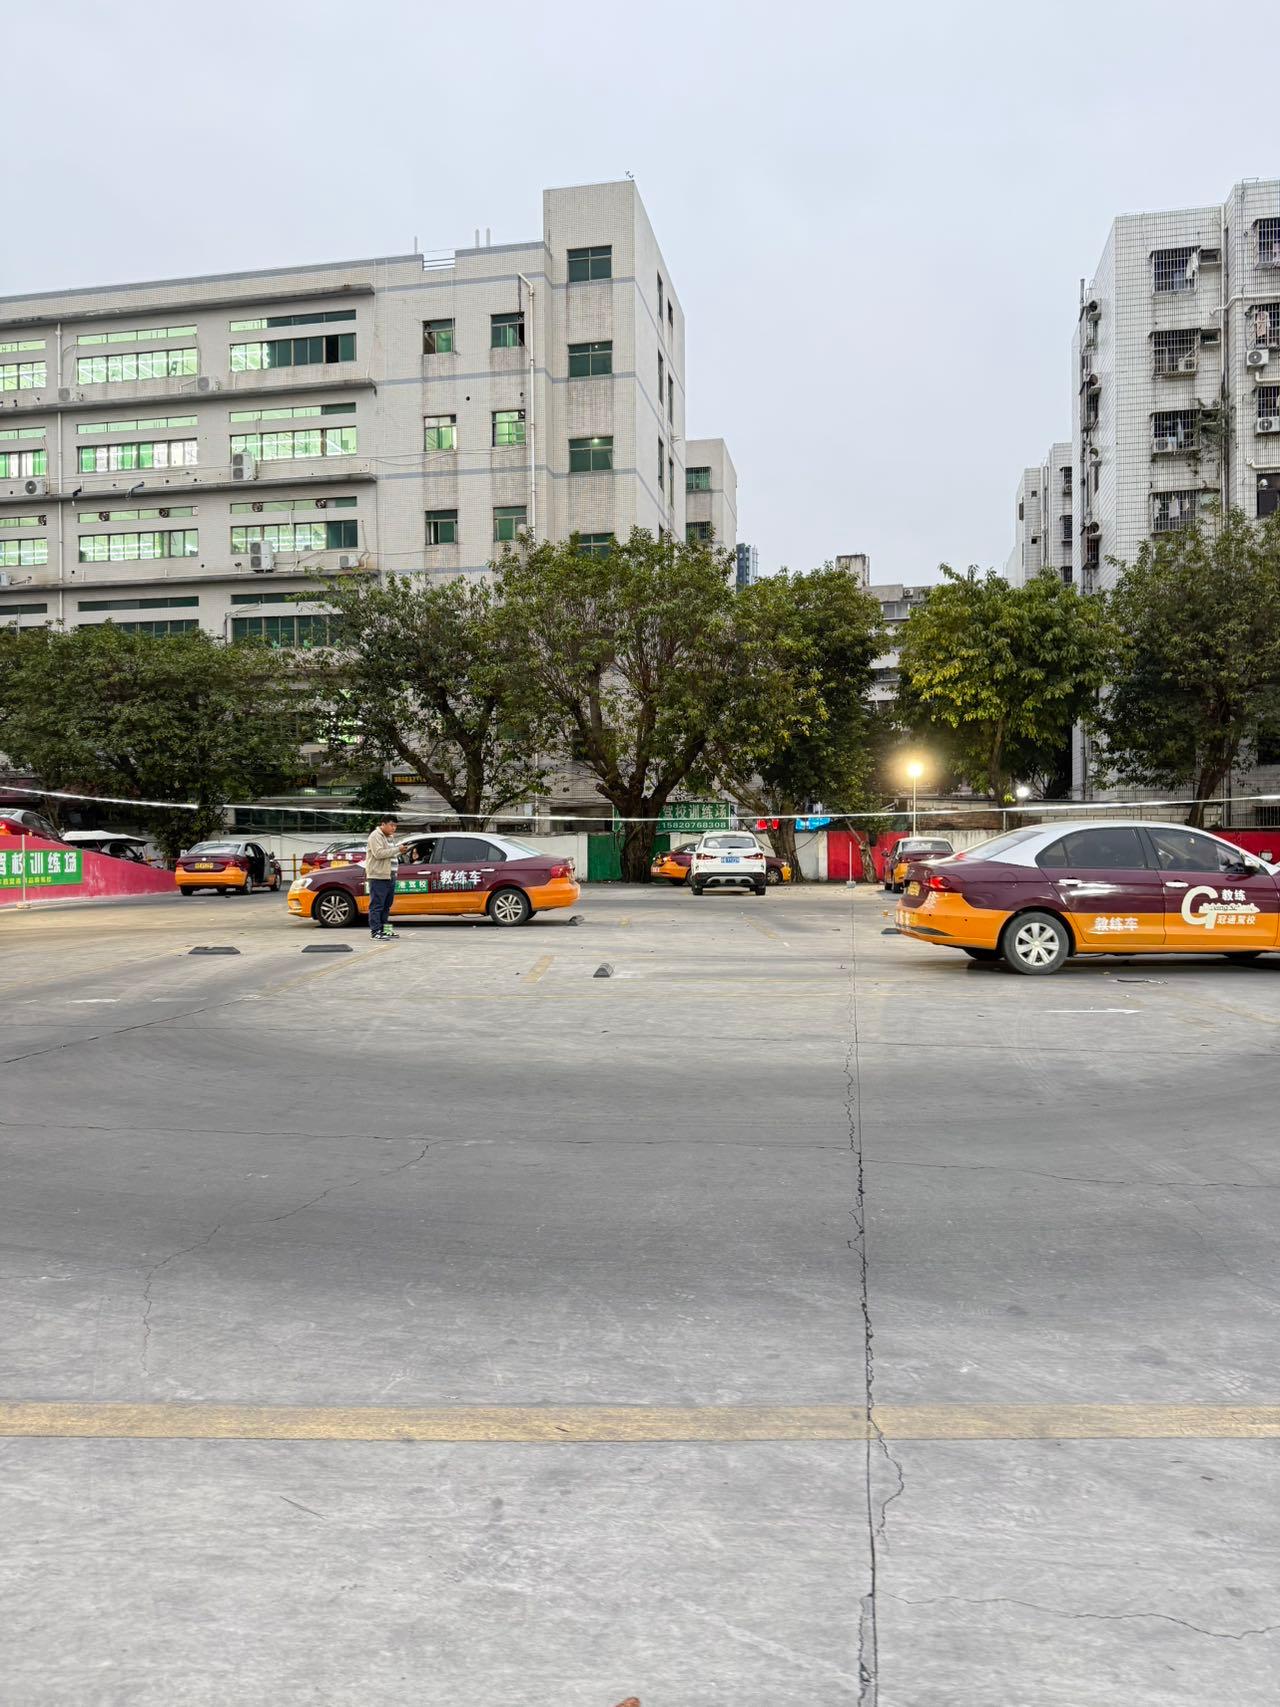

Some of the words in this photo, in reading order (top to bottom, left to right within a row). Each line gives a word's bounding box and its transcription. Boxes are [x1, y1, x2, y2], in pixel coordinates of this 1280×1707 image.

[662, 821, 727, 829] 15820768308
[440, 869, 482, 885] 教练车
[1221, 889, 1246, 901] 教练
